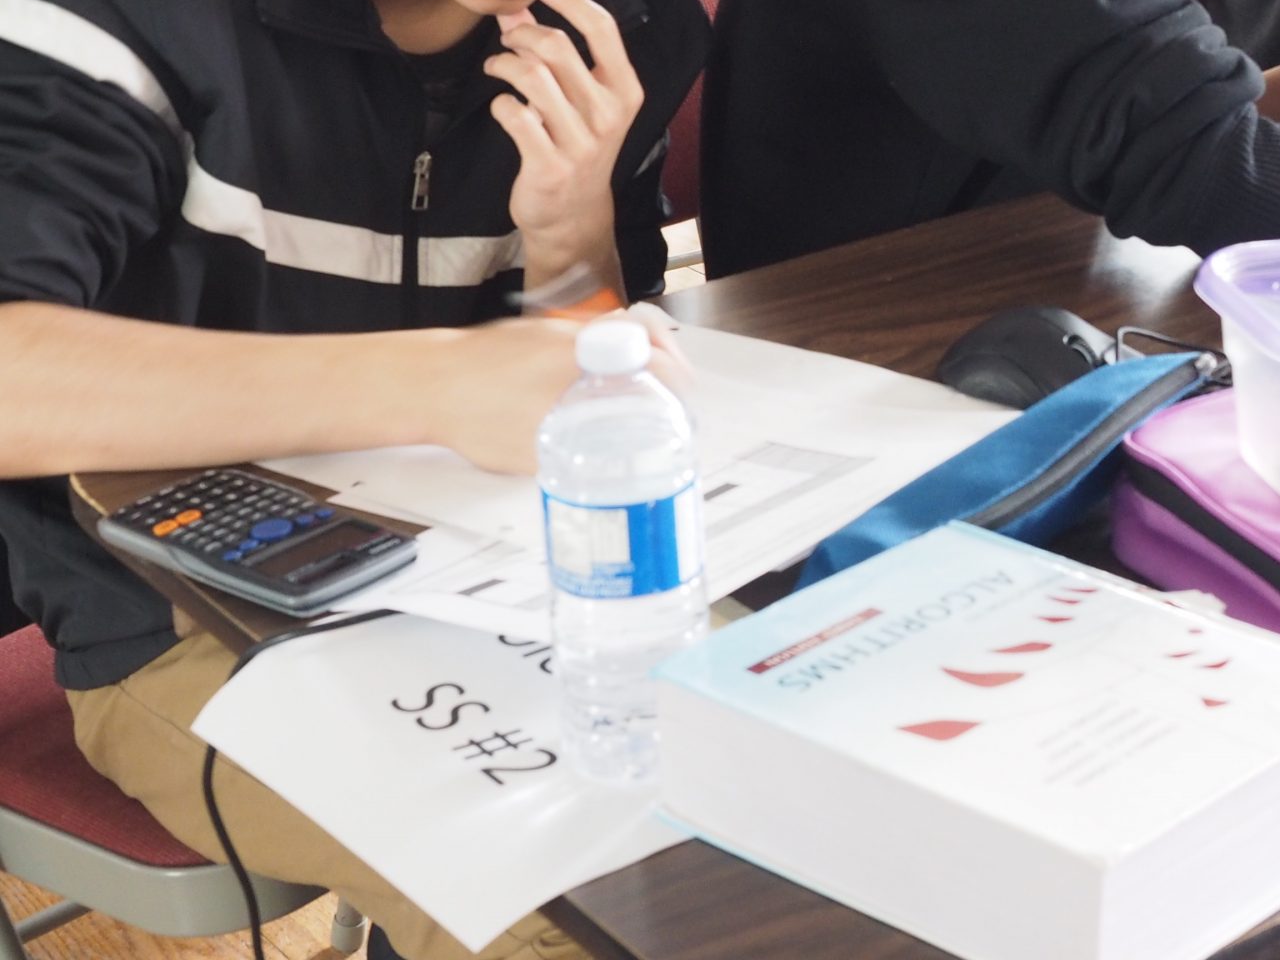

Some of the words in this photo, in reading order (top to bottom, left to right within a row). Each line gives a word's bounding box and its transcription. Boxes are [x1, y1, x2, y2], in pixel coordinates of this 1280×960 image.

[777, 570, 1015, 694] ALGORITHMS
[391, 682, 490, 731] SS
[452, 728, 557, 785] #2
